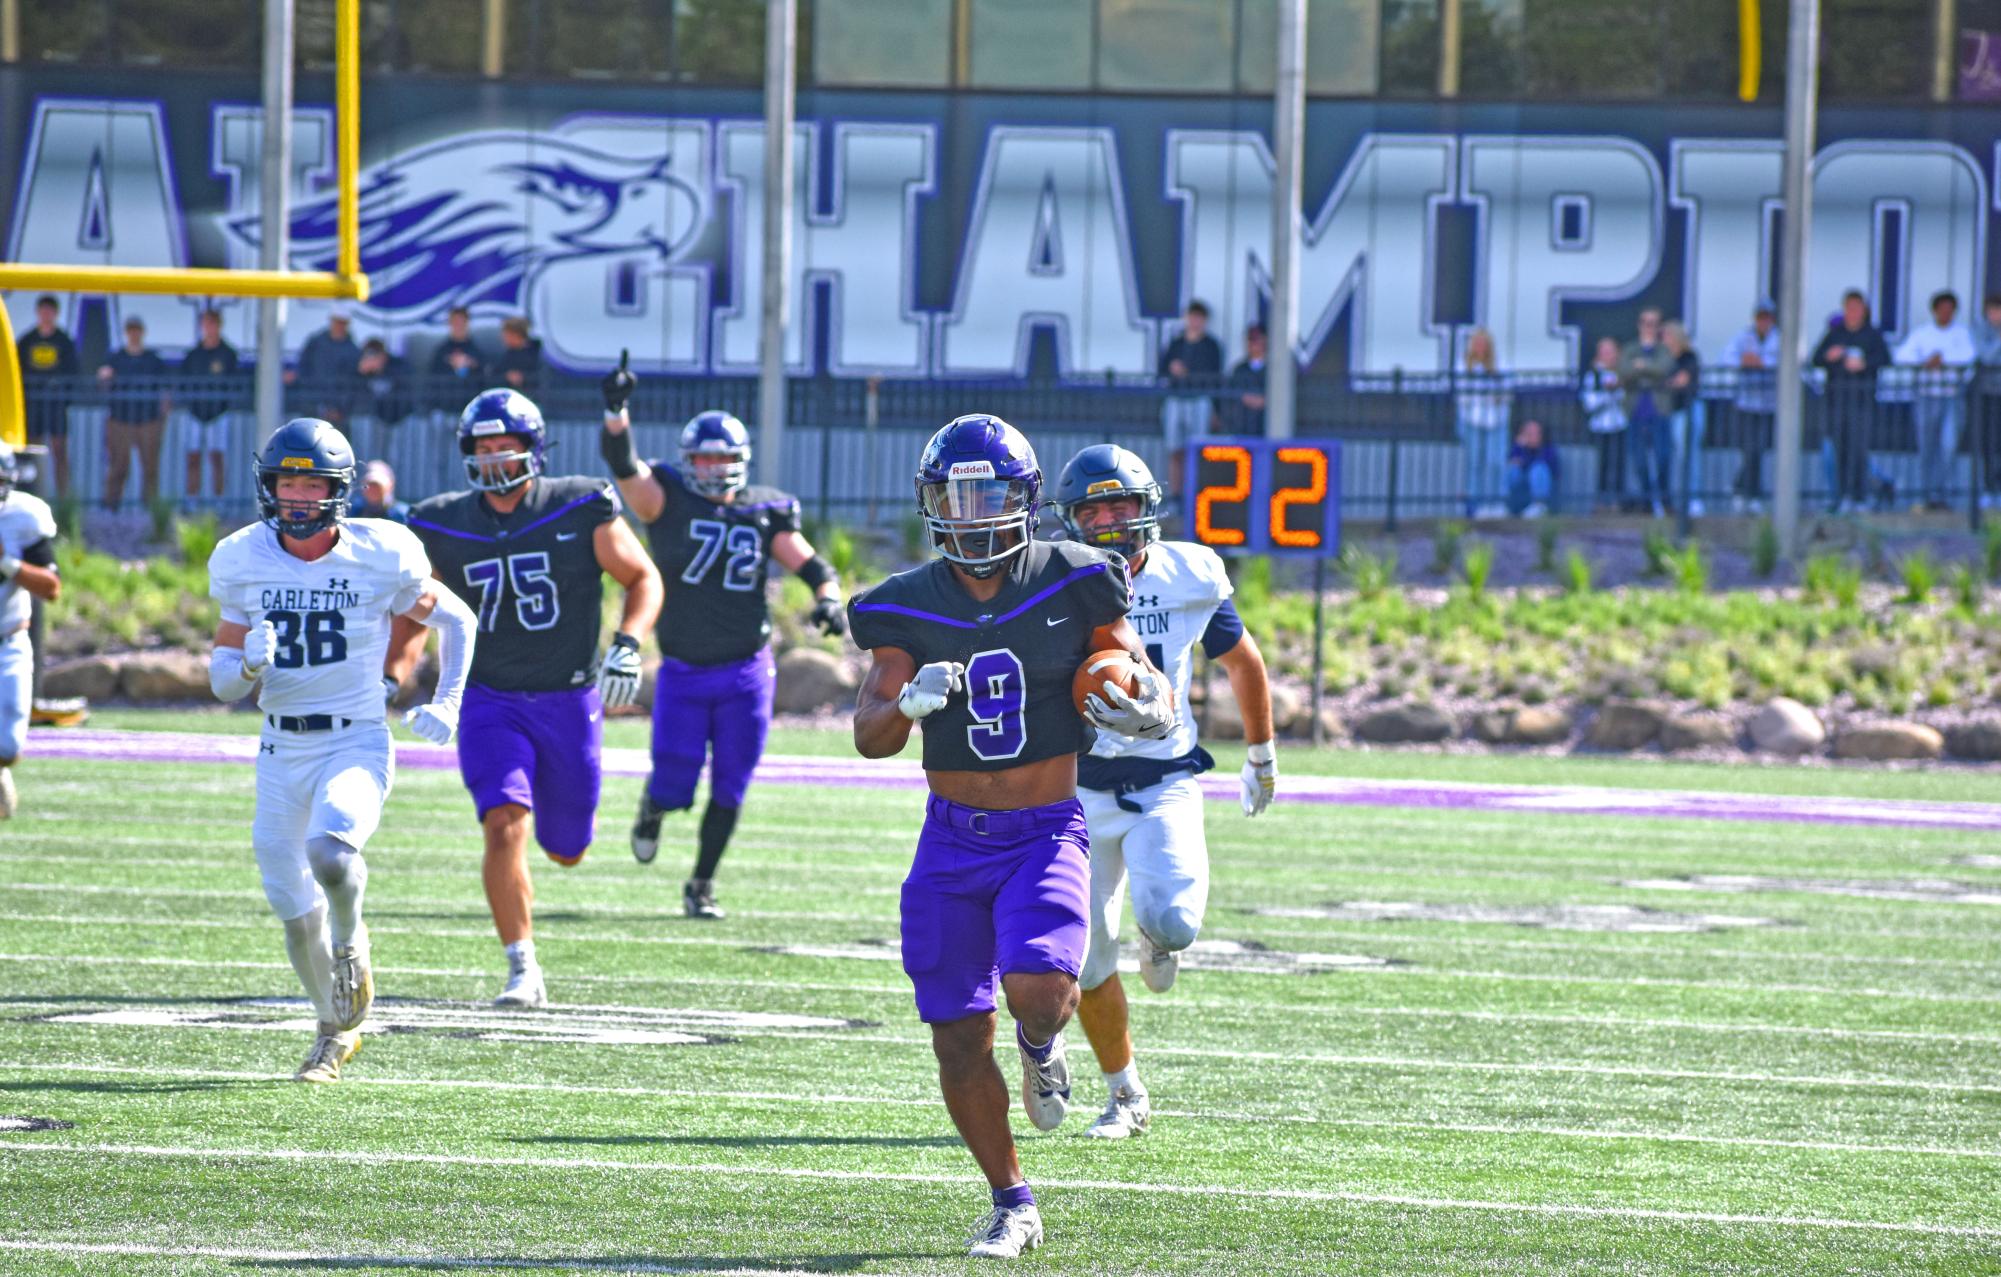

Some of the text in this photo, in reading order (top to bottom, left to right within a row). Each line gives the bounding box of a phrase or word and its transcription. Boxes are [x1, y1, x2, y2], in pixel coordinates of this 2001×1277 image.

[537, 113, 2001, 395] CHAMPIO
[952, 465, 990, 475] Riddell
[1195, 445, 1328, 547] 22
[463, 551, 560, 631] 75
[682, 518, 762, 591] 72
[261, 589, 359, 610] CARLETON
[1127, 611, 1170, 635] TON
[264, 609, 347, 669] 36
[964, 648, 1027, 761] 9
